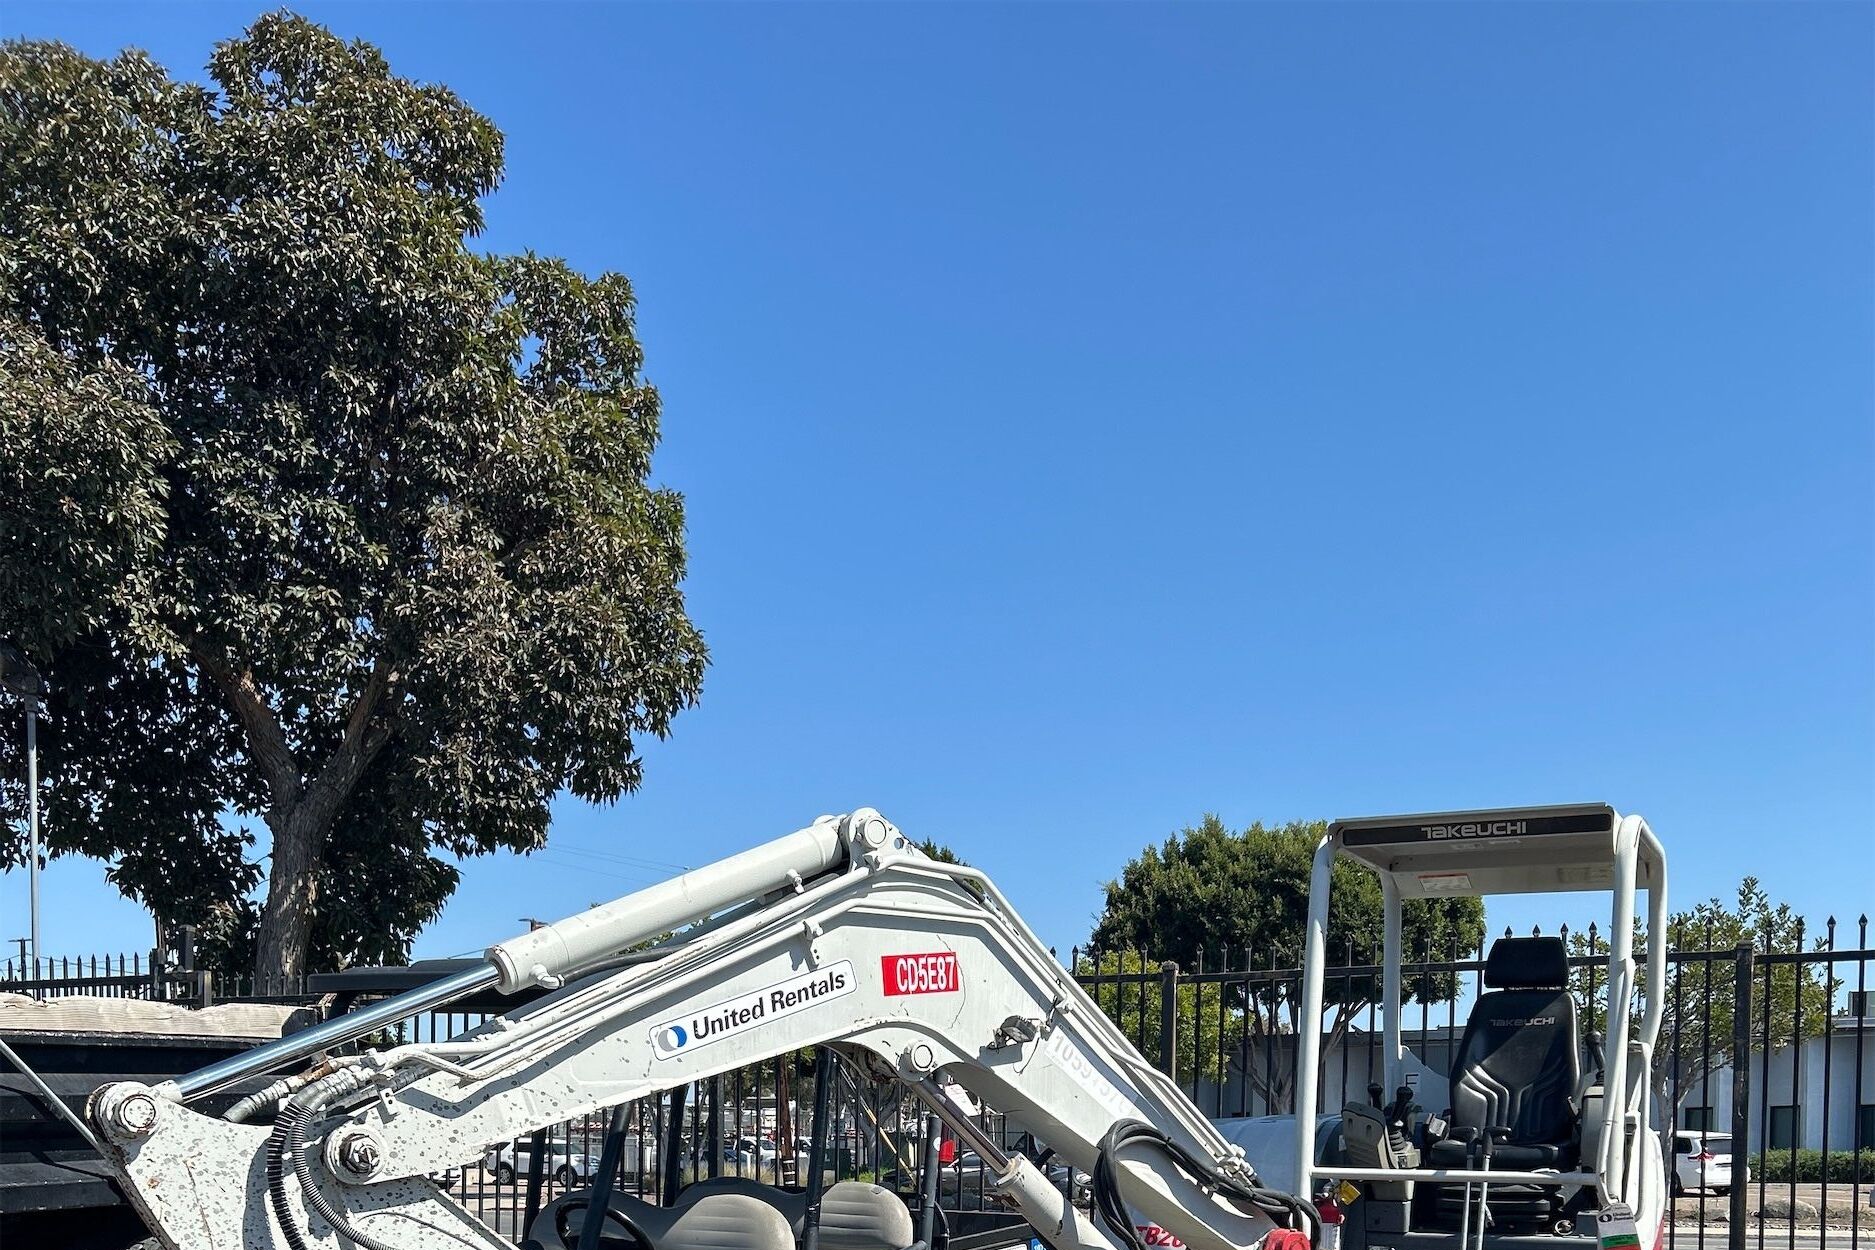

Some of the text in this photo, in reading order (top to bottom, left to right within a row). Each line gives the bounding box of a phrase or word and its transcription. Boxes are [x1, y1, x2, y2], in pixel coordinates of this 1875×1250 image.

[896, 955, 956, 992] CD5E87
[693, 970, 846, 1040] United Rentals
